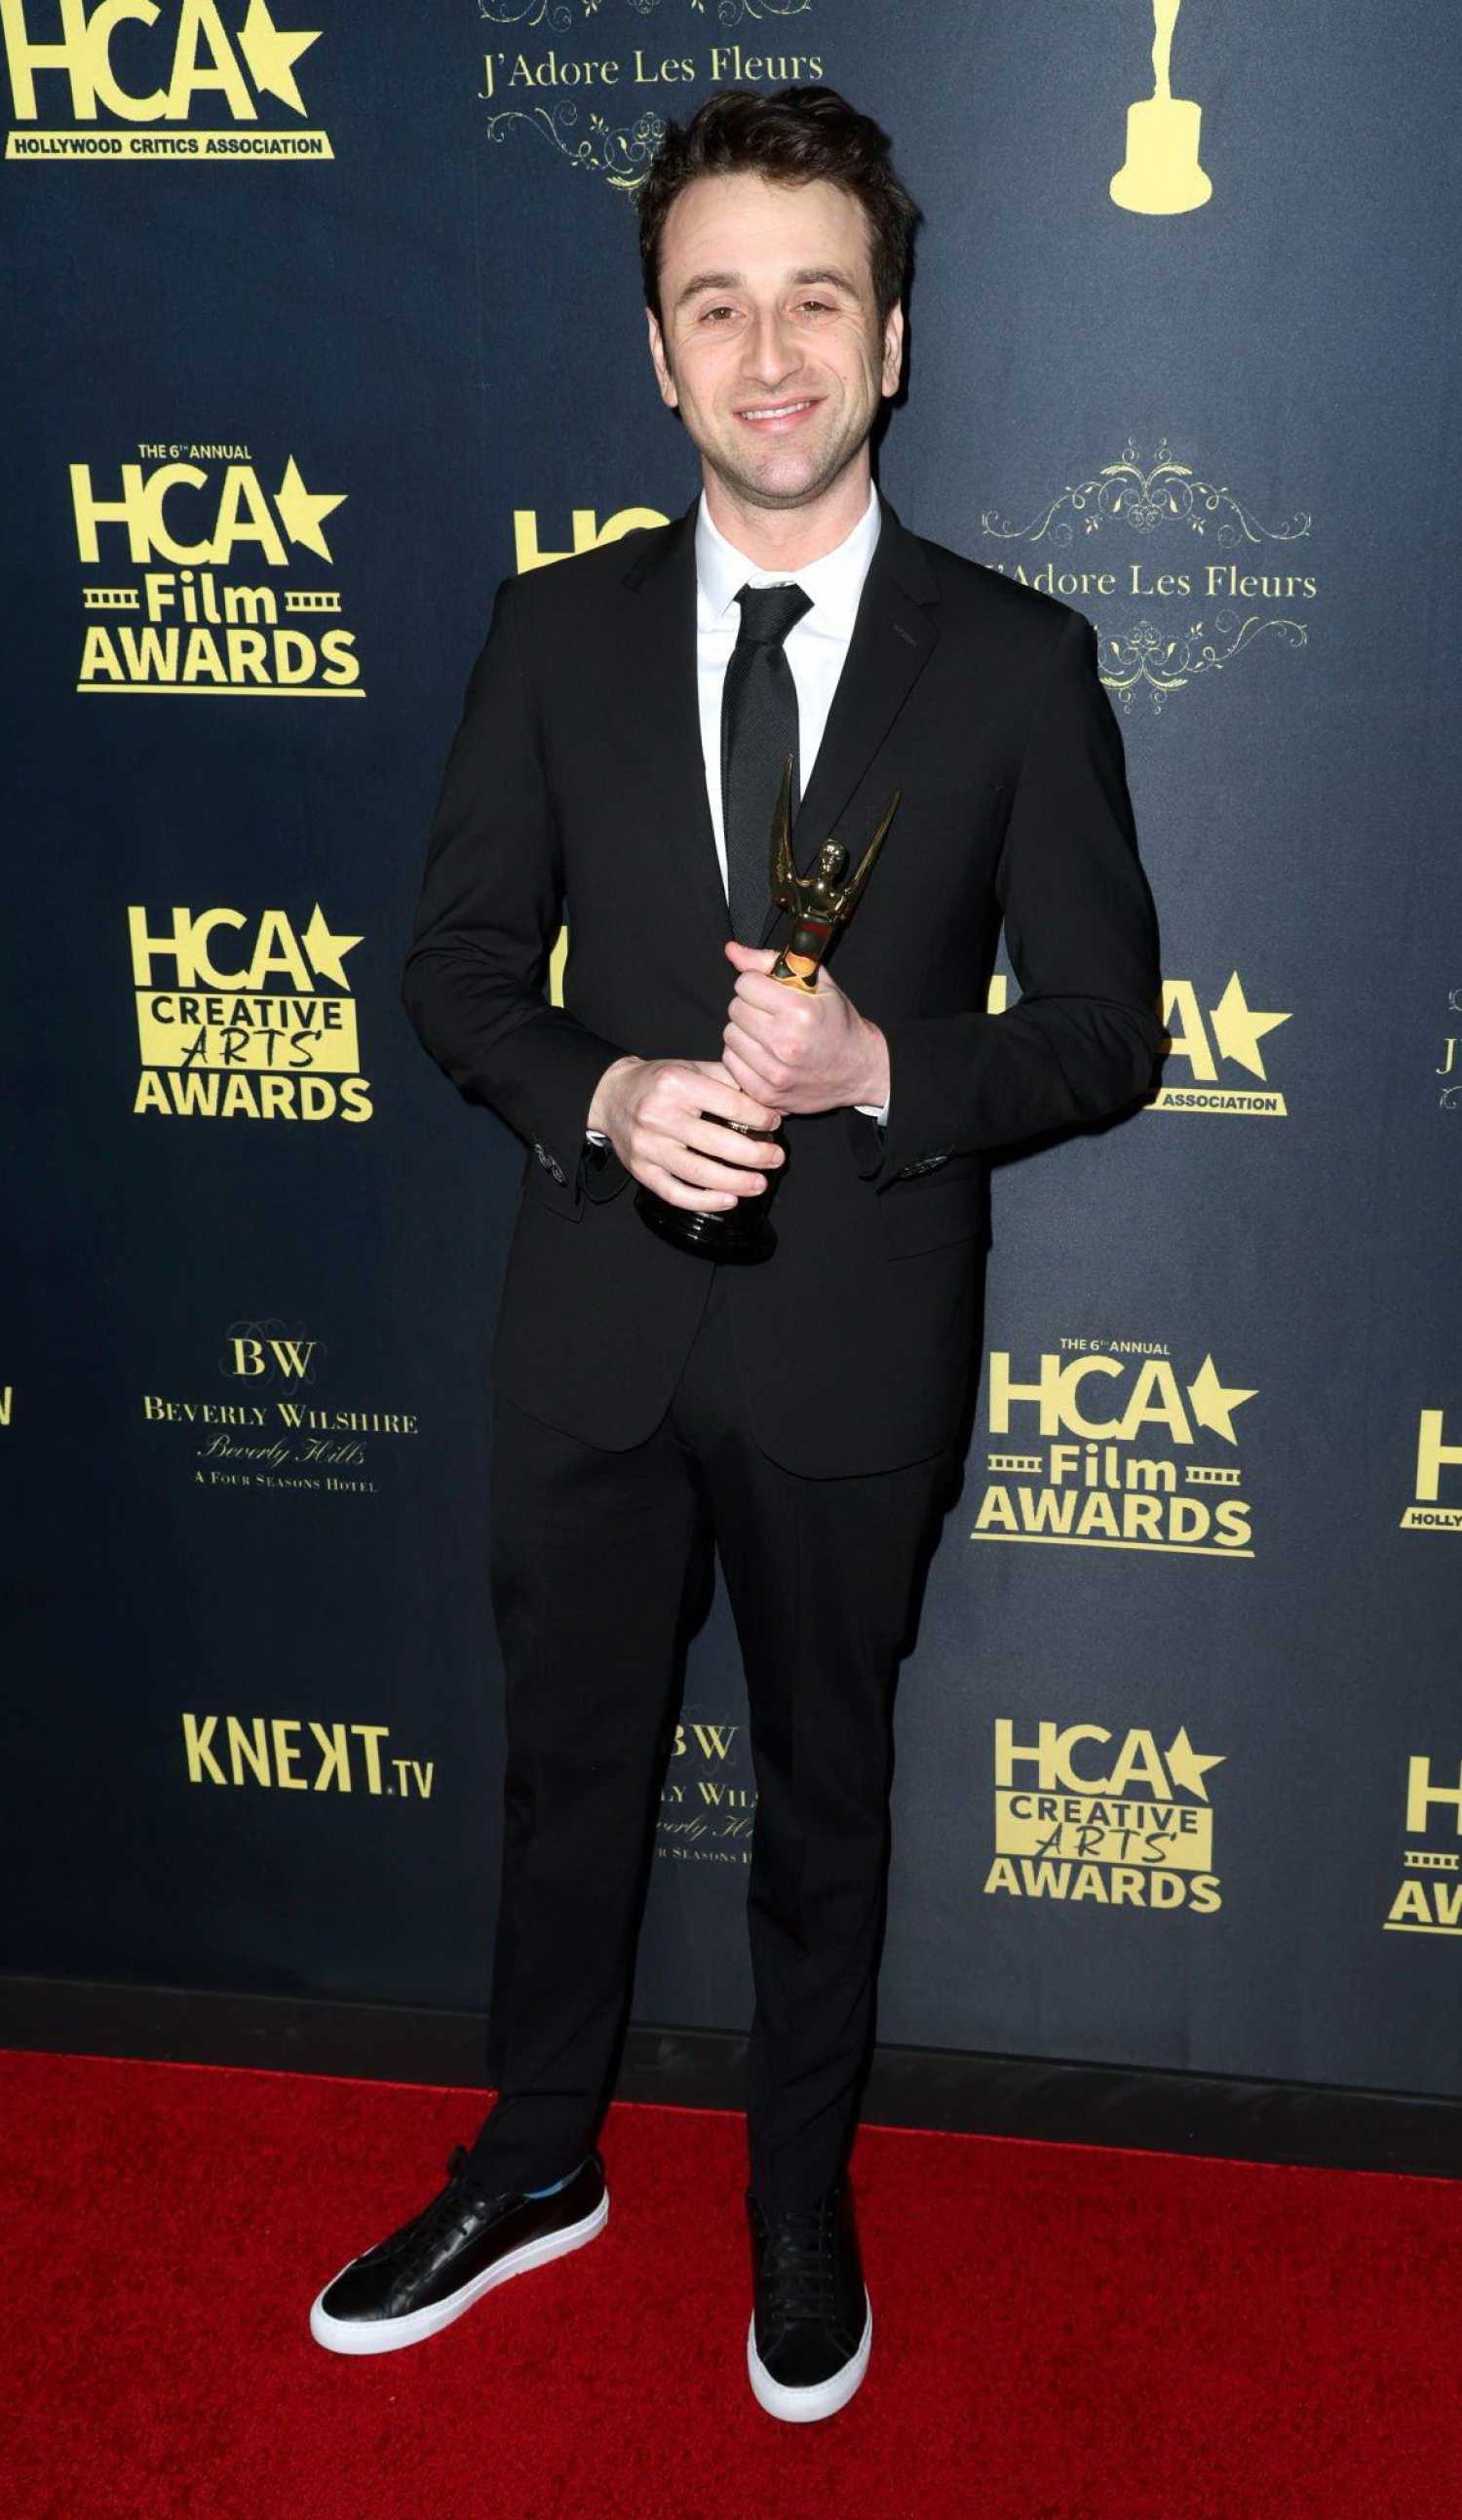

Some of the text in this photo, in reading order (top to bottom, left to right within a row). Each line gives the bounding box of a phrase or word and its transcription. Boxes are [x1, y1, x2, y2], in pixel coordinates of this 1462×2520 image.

[1, 0, 258, 122] HCA
[478, 46, 824, 98] J'Adore Les Fleurs
[15, 137, 323, 154] HOLLYWOOD CRITICS ASSOCIATION
[138, 445, 166, 458] THE
[189, 445, 251, 459] ANNUAL
[69, 463, 289, 565] HCA
[144, 570, 278, 624] Film
[984, 563, 1317, 599] 'Adore Les Fleurs
[80, 627, 360, 685] AWARDS
[128, 906, 315, 991] HCA
[151, 995, 342, 1029] CREATIVE
[134, 1070, 373, 1123] AWARDS
[1163, 1092, 1277, 1111] ASSOCIATION
[230, 1338, 317, 1378] BW
[1060, 1338, 1087, 1351] THE
[1109, 1341, 1171, 1355] ANNUAL
[144, 1395, 419, 1434] BEVERLY WILSHIRE
[988, 1351, 1194, 1445] HCA
[197, 1433, 367, 1467] Beverly Hills
[1050, 1443, 1176, 1492] Film
[194, 1470, 378, 1493] A FOUR SEASONS HOTEL
[975, 1486, 1251, 1546] AWARDS
[995, 1719, 1173, 1801] HCA
[1010, 1795, 1198, 1834] CREATIVE
[983, 1857, 1222, 1914] AWARDS
